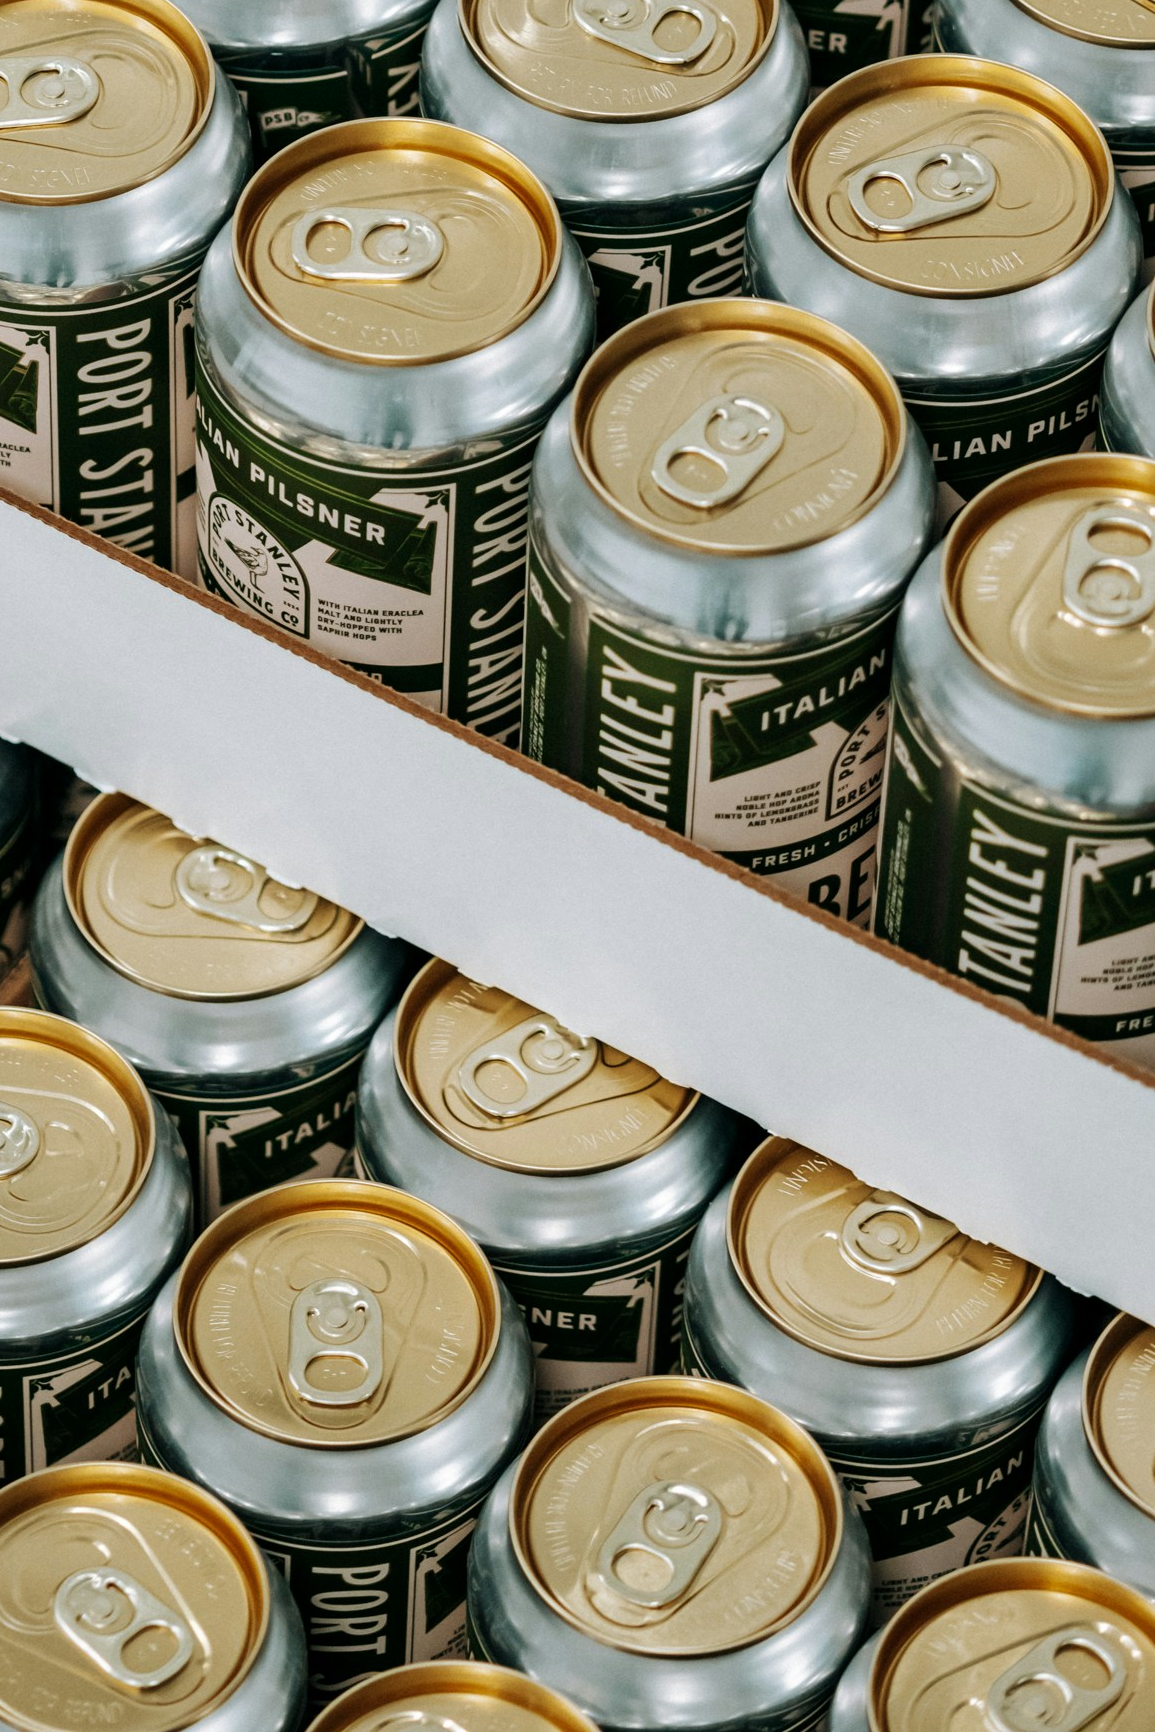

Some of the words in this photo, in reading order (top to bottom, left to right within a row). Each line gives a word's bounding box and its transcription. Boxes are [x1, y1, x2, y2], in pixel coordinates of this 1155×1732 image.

[76, 317, 153, 436] PORT
[931, 430, 1013, 463] LIAN
[250, 462, 387, 547] PILSNER
[212, 502, 231, 541] PORT
[234, 509, 300, 602] STANLEY
[211, 545, 274, 615] BREWING
[317, 607, 342, 619] MALT
[343, 614, 362, 623] AND
[365, 617, 404, 627] LIGHTLY
[318, 598, 341, 609] WITH
[343, 605, 379, 617] ITALIAN
[381, 608, 424, 617] ERACLEA
[317, 615, 376, 634] DRY-HOPPED
[379, 626, 403, 635] WITH
[317, 623, 350, 638] SAPHIR
[352, 632, 377, 642] HOPS
[760, 649, 887, 732] ITALIAN
[838, 725, 872, 782] PORT
[735, 802, 767, 811] NOBLE
[769, 799, 788, 808] HOP
[789, 790, 821, 804] AROMA
[744, 793, 772, 802] LIGHT
[774, 788, 793, 798] AND
[795, 781, 822, 795] CRISP
[836, 768, 882, 810] BREW
[714, 812, 743, 820] HINTS
[746, 811, 758, 819] OF
[760, 798, 820, 818] LEMONGRASS
[747, 819, 767, 828] AND
[770, 807, 819, 825] TANGERINE
[751, 844, 817, 870] FRESH
[1116, 1015, 1155, 1033] FRE
[265, 1090, 357, 1159] ITALIA
[900, 1450, 1024, 1527] ITALIAN
[309, 1561, 390, 1656] PORT
